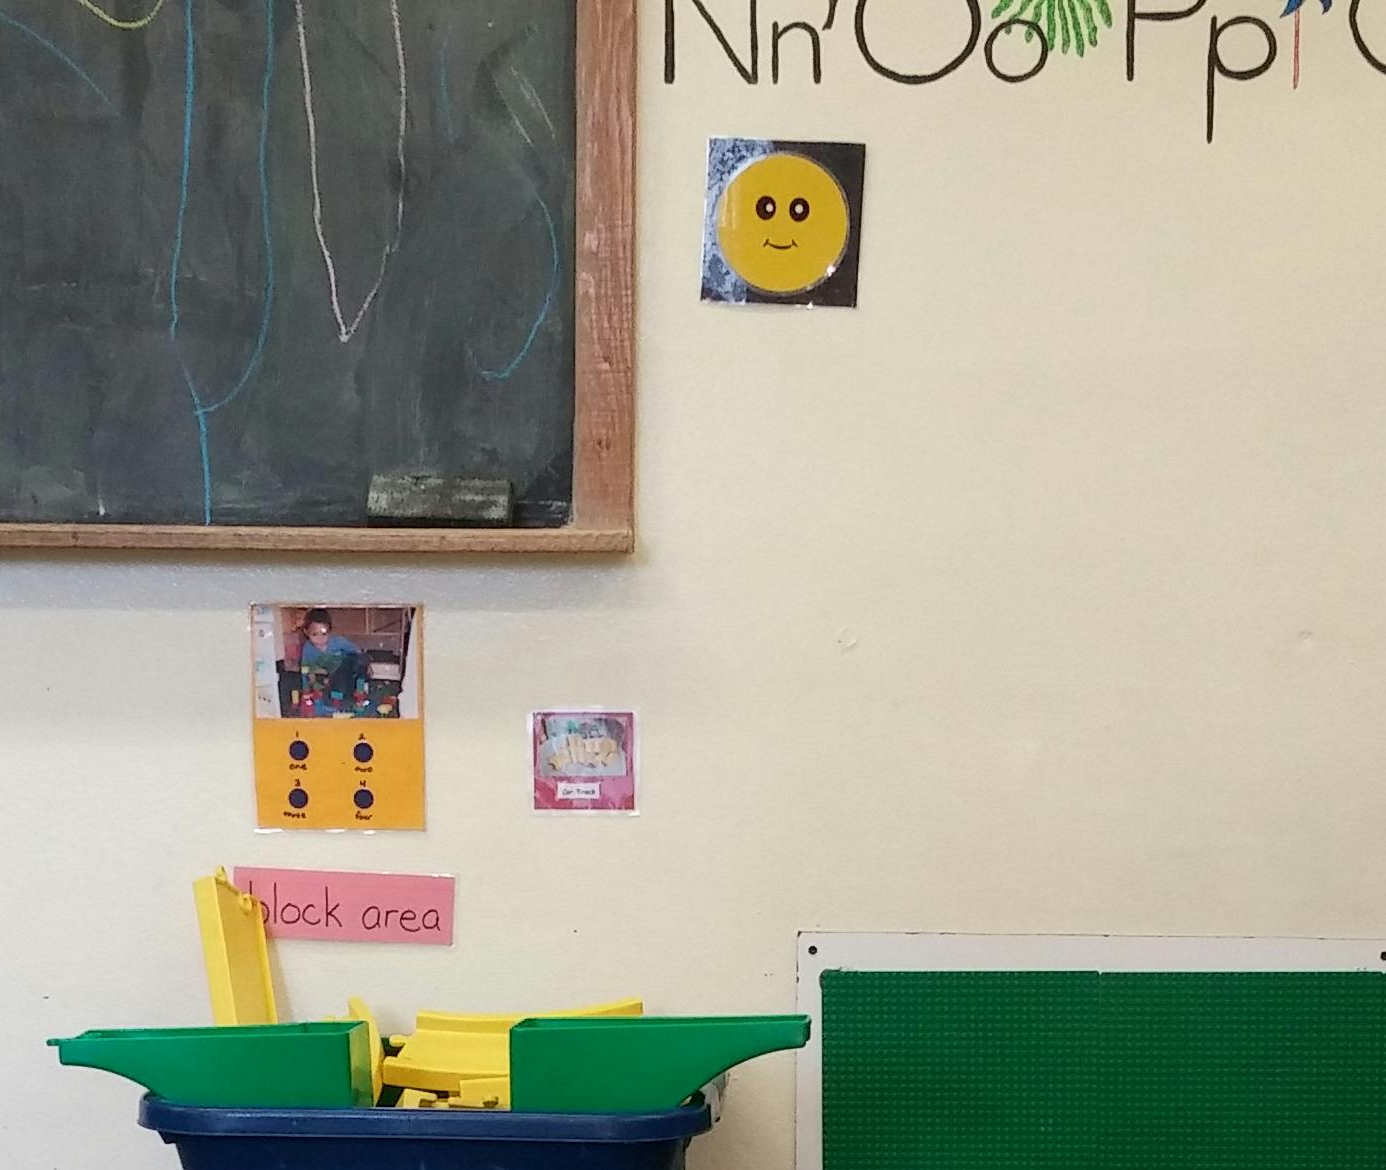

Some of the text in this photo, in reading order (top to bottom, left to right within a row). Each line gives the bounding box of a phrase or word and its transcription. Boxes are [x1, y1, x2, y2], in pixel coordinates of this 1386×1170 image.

[664, 0, 822, 84] Nn
[1126, 0, 1277, 144] Pp
[361, 905, 441, 933] area
